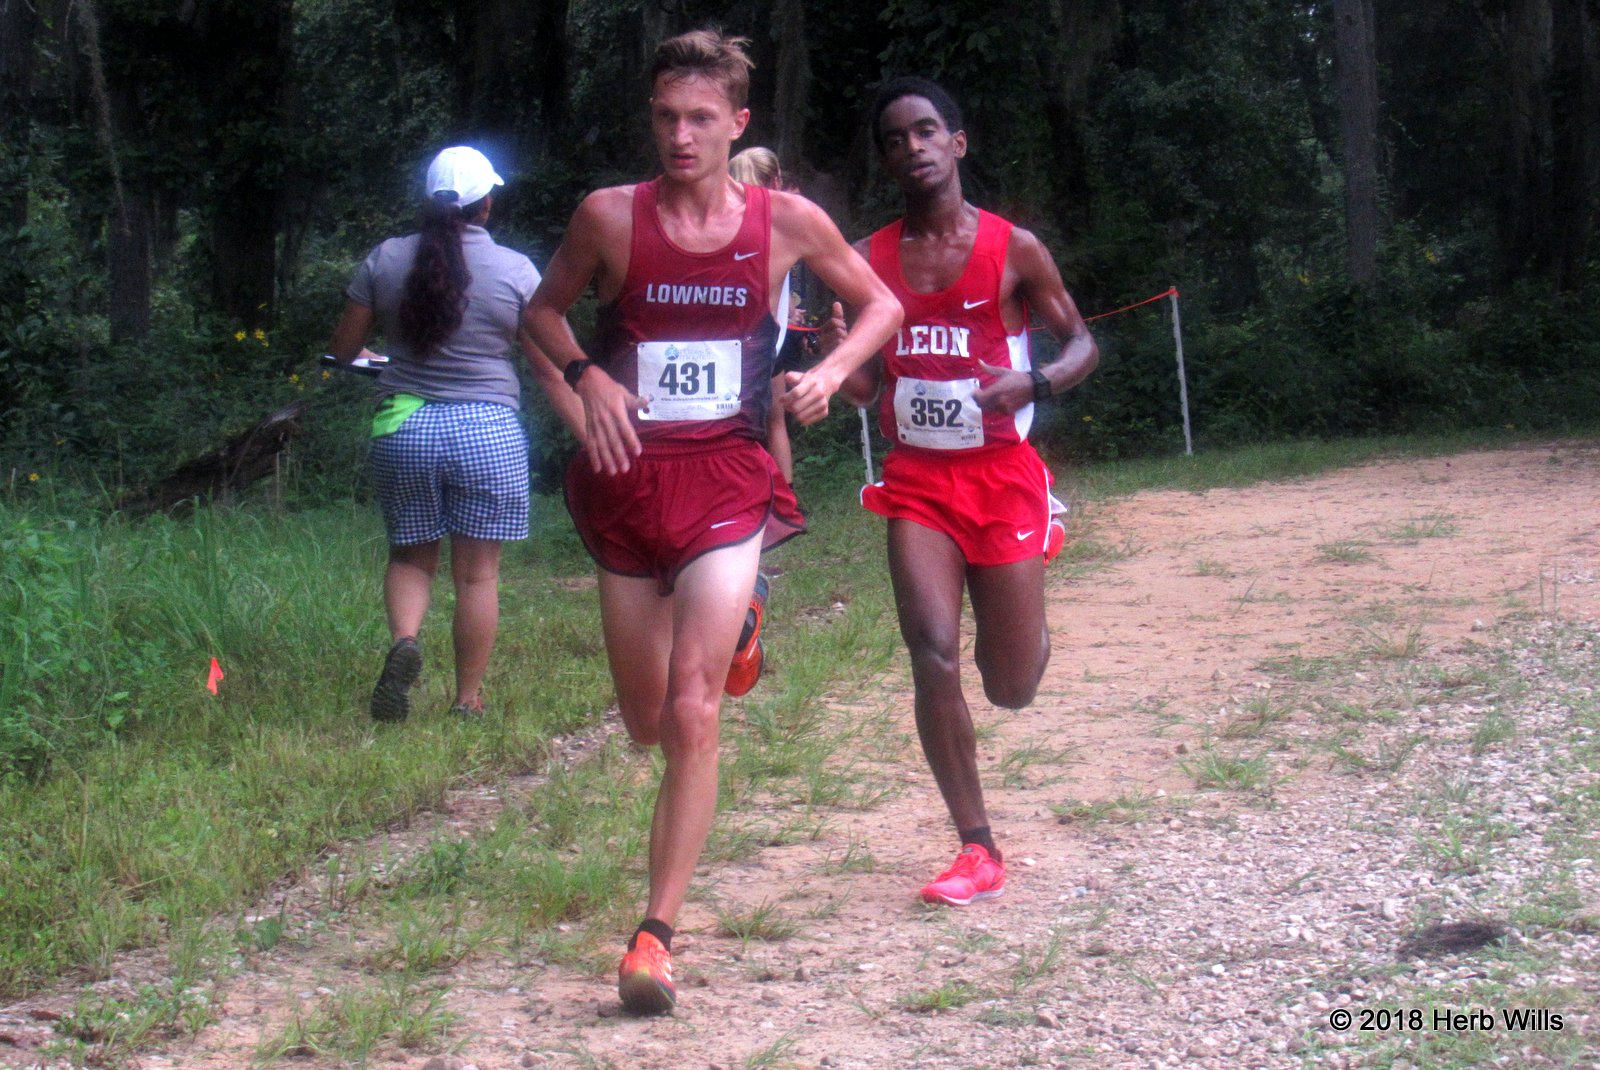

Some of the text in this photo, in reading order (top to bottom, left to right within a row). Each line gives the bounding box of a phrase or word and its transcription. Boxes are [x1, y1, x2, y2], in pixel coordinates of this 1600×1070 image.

[646, 283, 748, 307] LOWNDES
[895, 325, 970, 358] LEON
[658, 362, 716, 396] 431
[910, 397, 964, 427] 352
